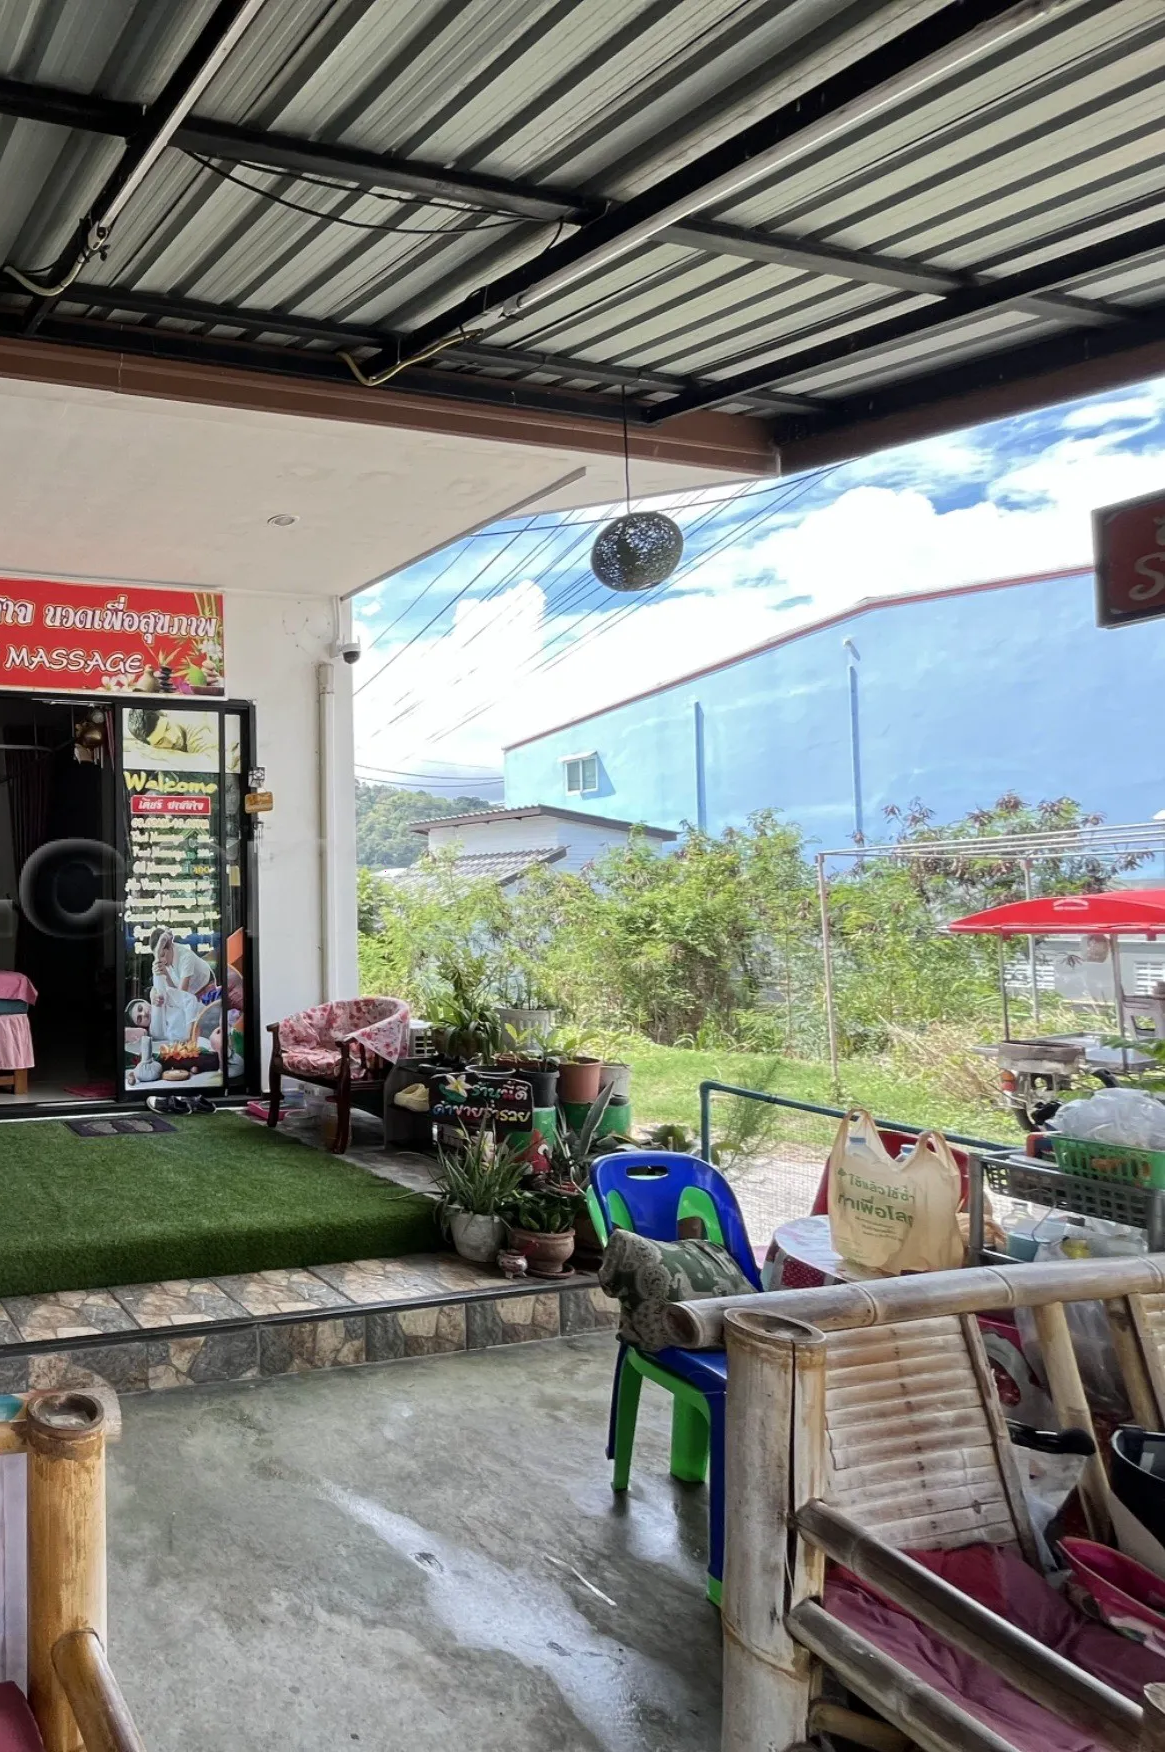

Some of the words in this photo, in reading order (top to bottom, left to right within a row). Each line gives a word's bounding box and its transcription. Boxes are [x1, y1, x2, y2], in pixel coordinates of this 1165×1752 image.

[44, 595, 219, 646] นวดเพื่อสุขภาพ
[3, 644, 145, 675] MASSAGE
[123, 770, 218, 794] Welcome
